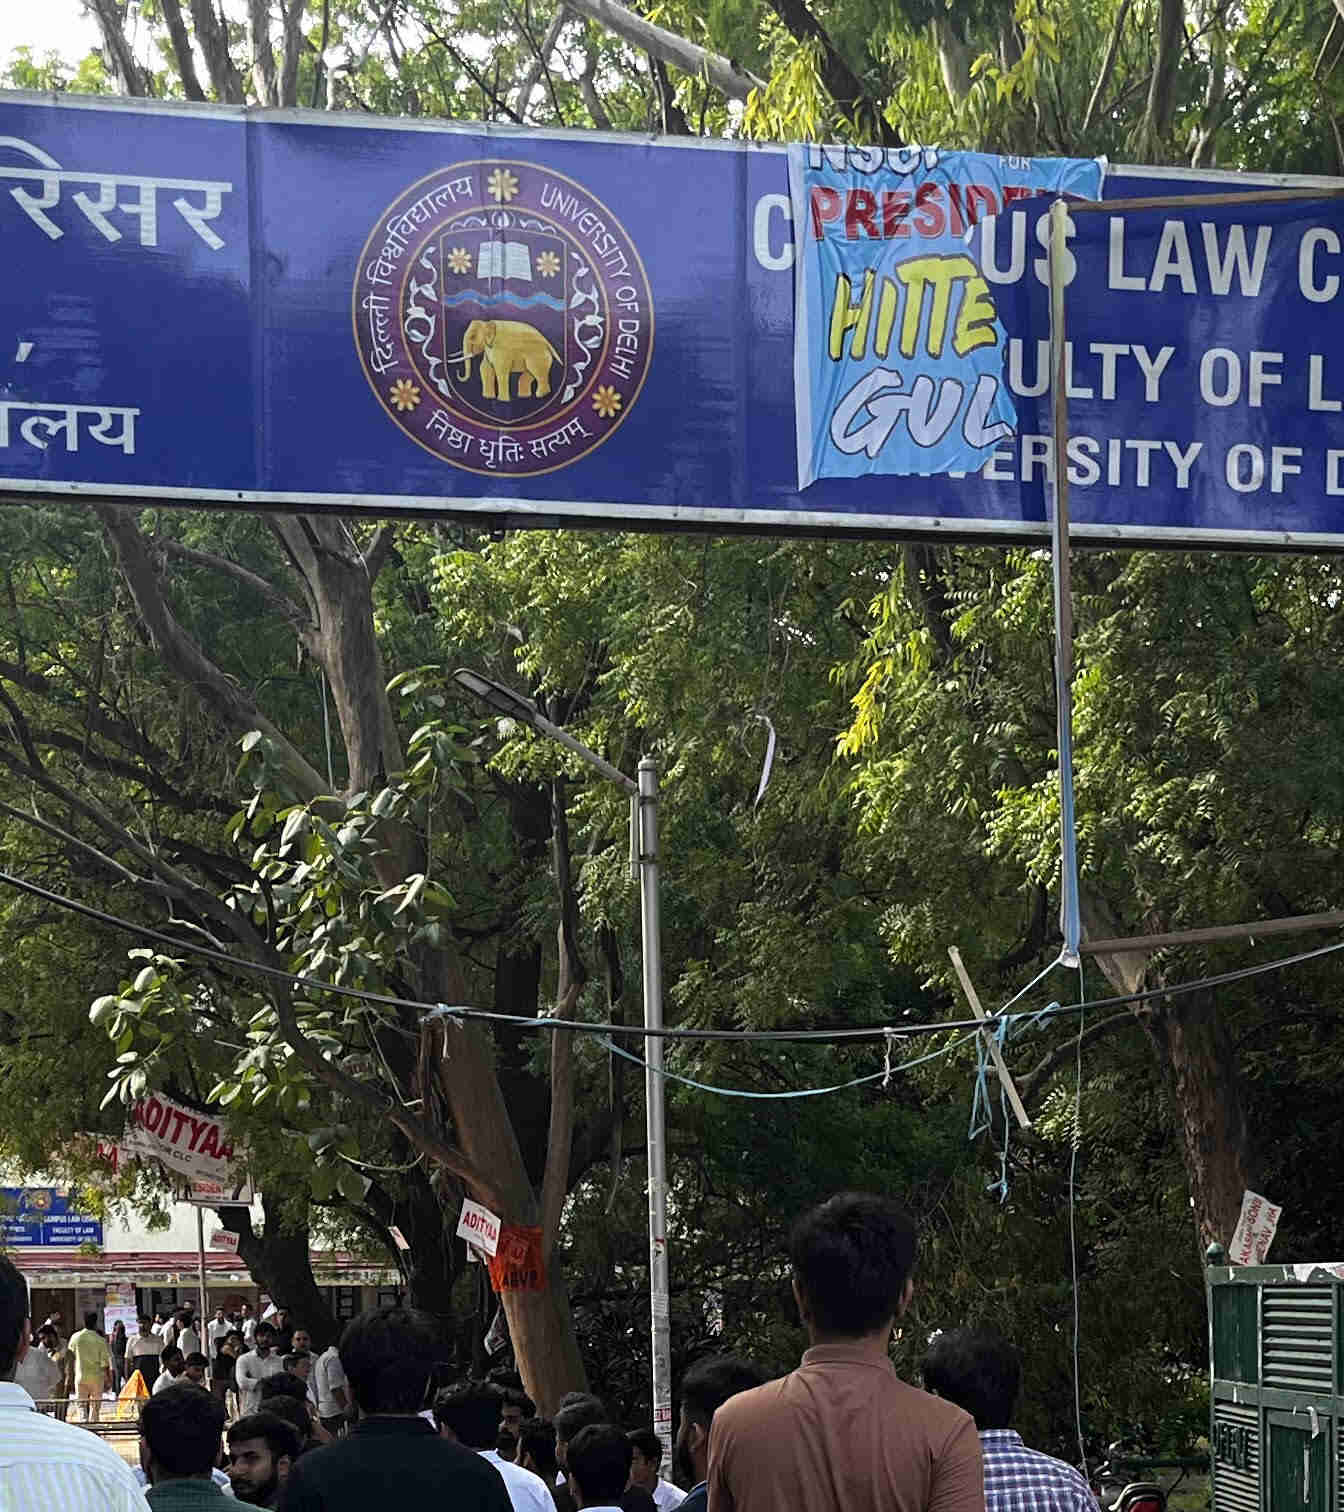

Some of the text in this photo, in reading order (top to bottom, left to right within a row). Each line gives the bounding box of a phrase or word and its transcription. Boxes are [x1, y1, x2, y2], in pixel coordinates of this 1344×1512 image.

[539, 182, 640, 381] UNIVERSITY OF DELHI
[1107, 216, 1272, 297] LAW
[1199, 347, 1284, 408] OF
[1225, 443, 1303, 494] OF
